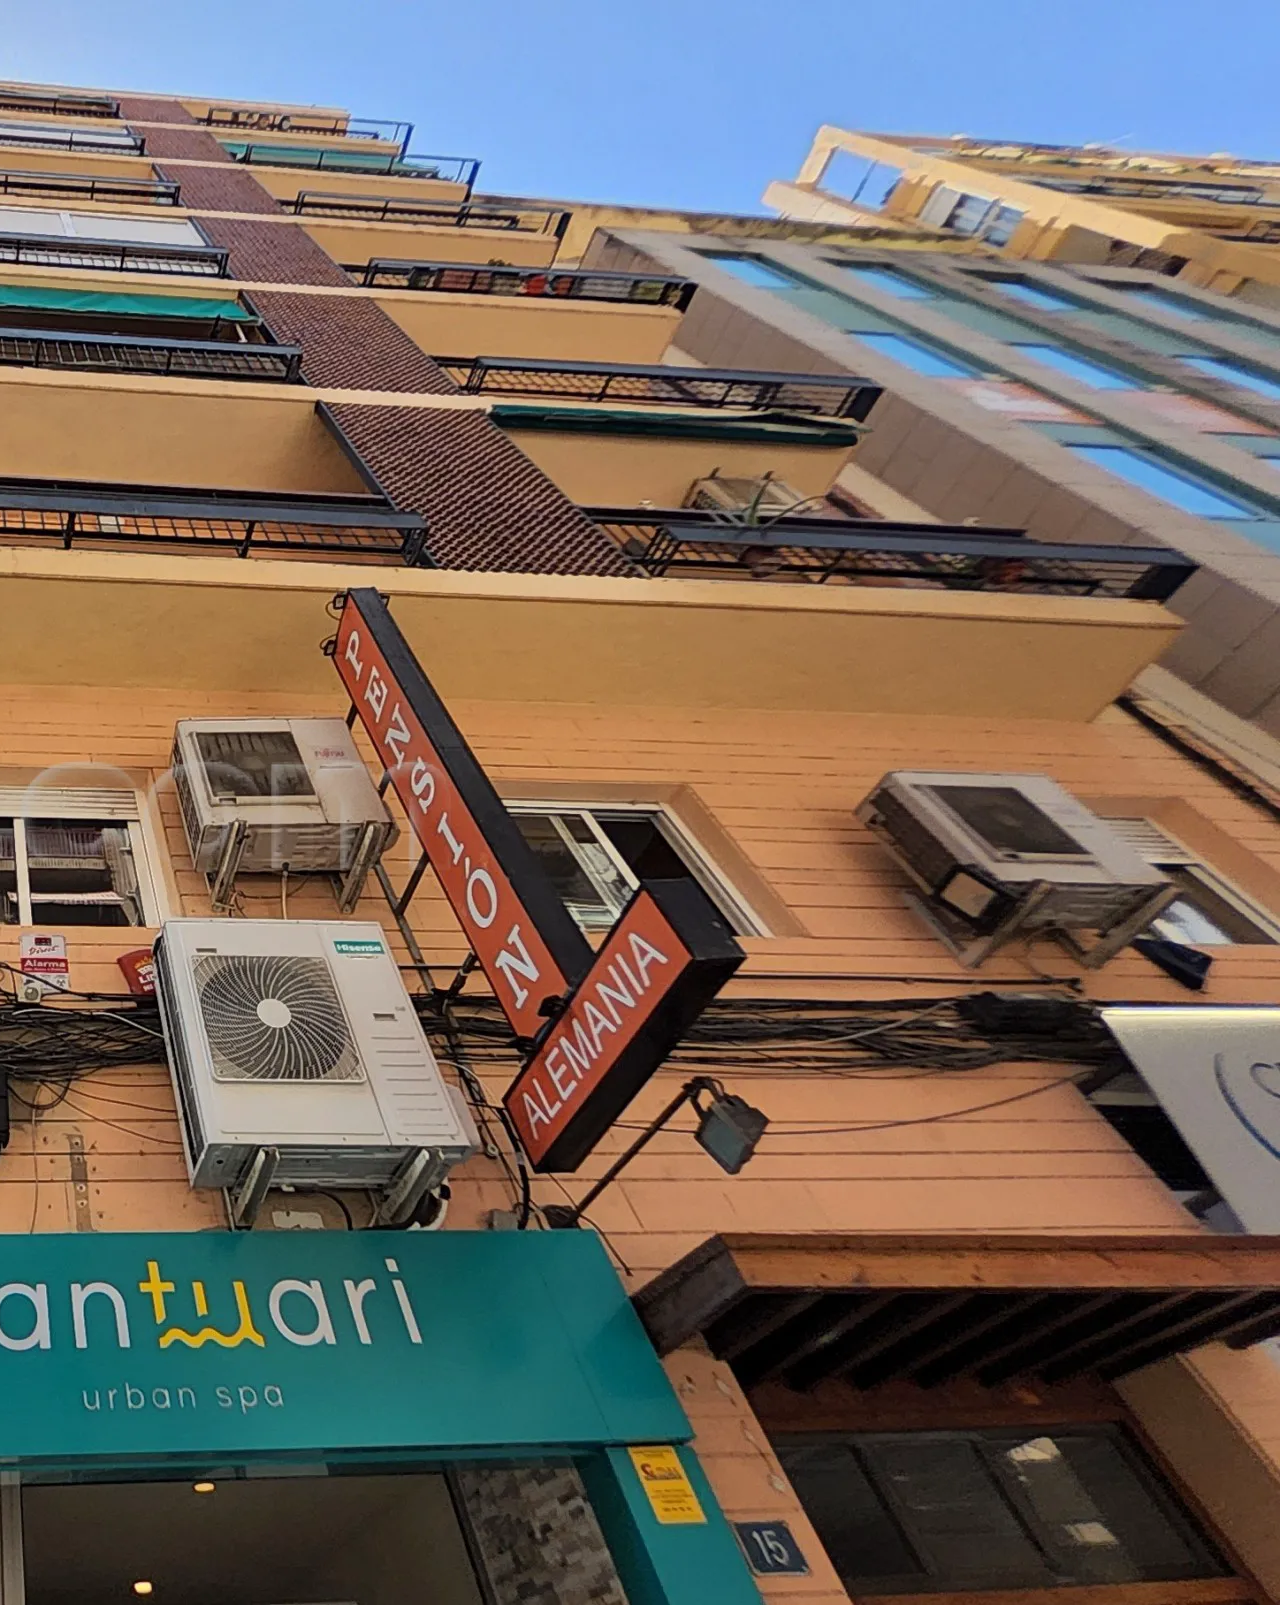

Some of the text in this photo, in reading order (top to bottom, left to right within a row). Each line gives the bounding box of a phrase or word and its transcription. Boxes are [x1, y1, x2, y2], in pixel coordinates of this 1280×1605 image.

[344, 629, 540, 1011] PENSIÓN
[23, 959, 66, 968] Alarma
[521, 931, 669, 1140] ALEMANIA
[81, 1382, 285, 1414] urban spa
[751, 1529, 790, 1567] 15
